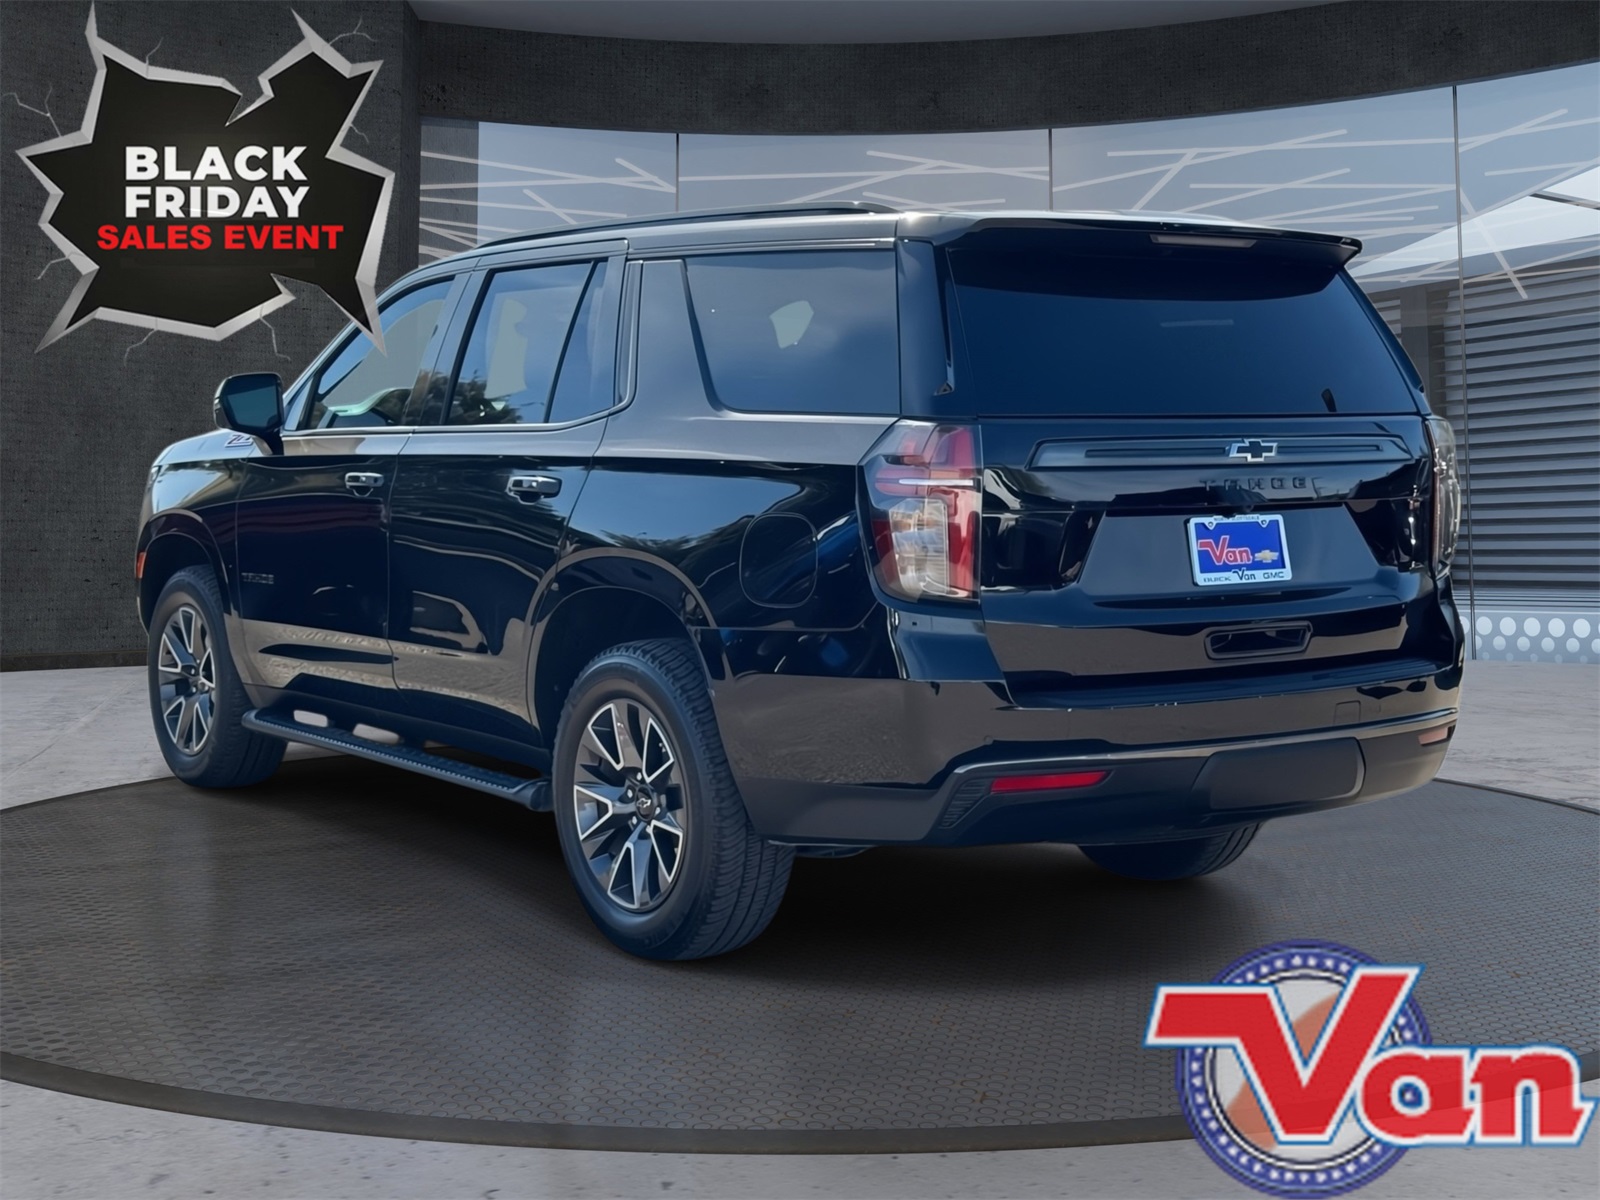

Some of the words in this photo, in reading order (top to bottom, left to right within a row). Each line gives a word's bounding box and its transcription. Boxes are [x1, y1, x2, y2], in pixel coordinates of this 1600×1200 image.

[1199, 476, 1306, 491] TAHOE
[1198, 535, 1253, 565] Van
[1203, 575, 1231, 583] BUICK
[1232, 567, 1256, 580] Van
[1263, 571, 1285, 579] GMC
